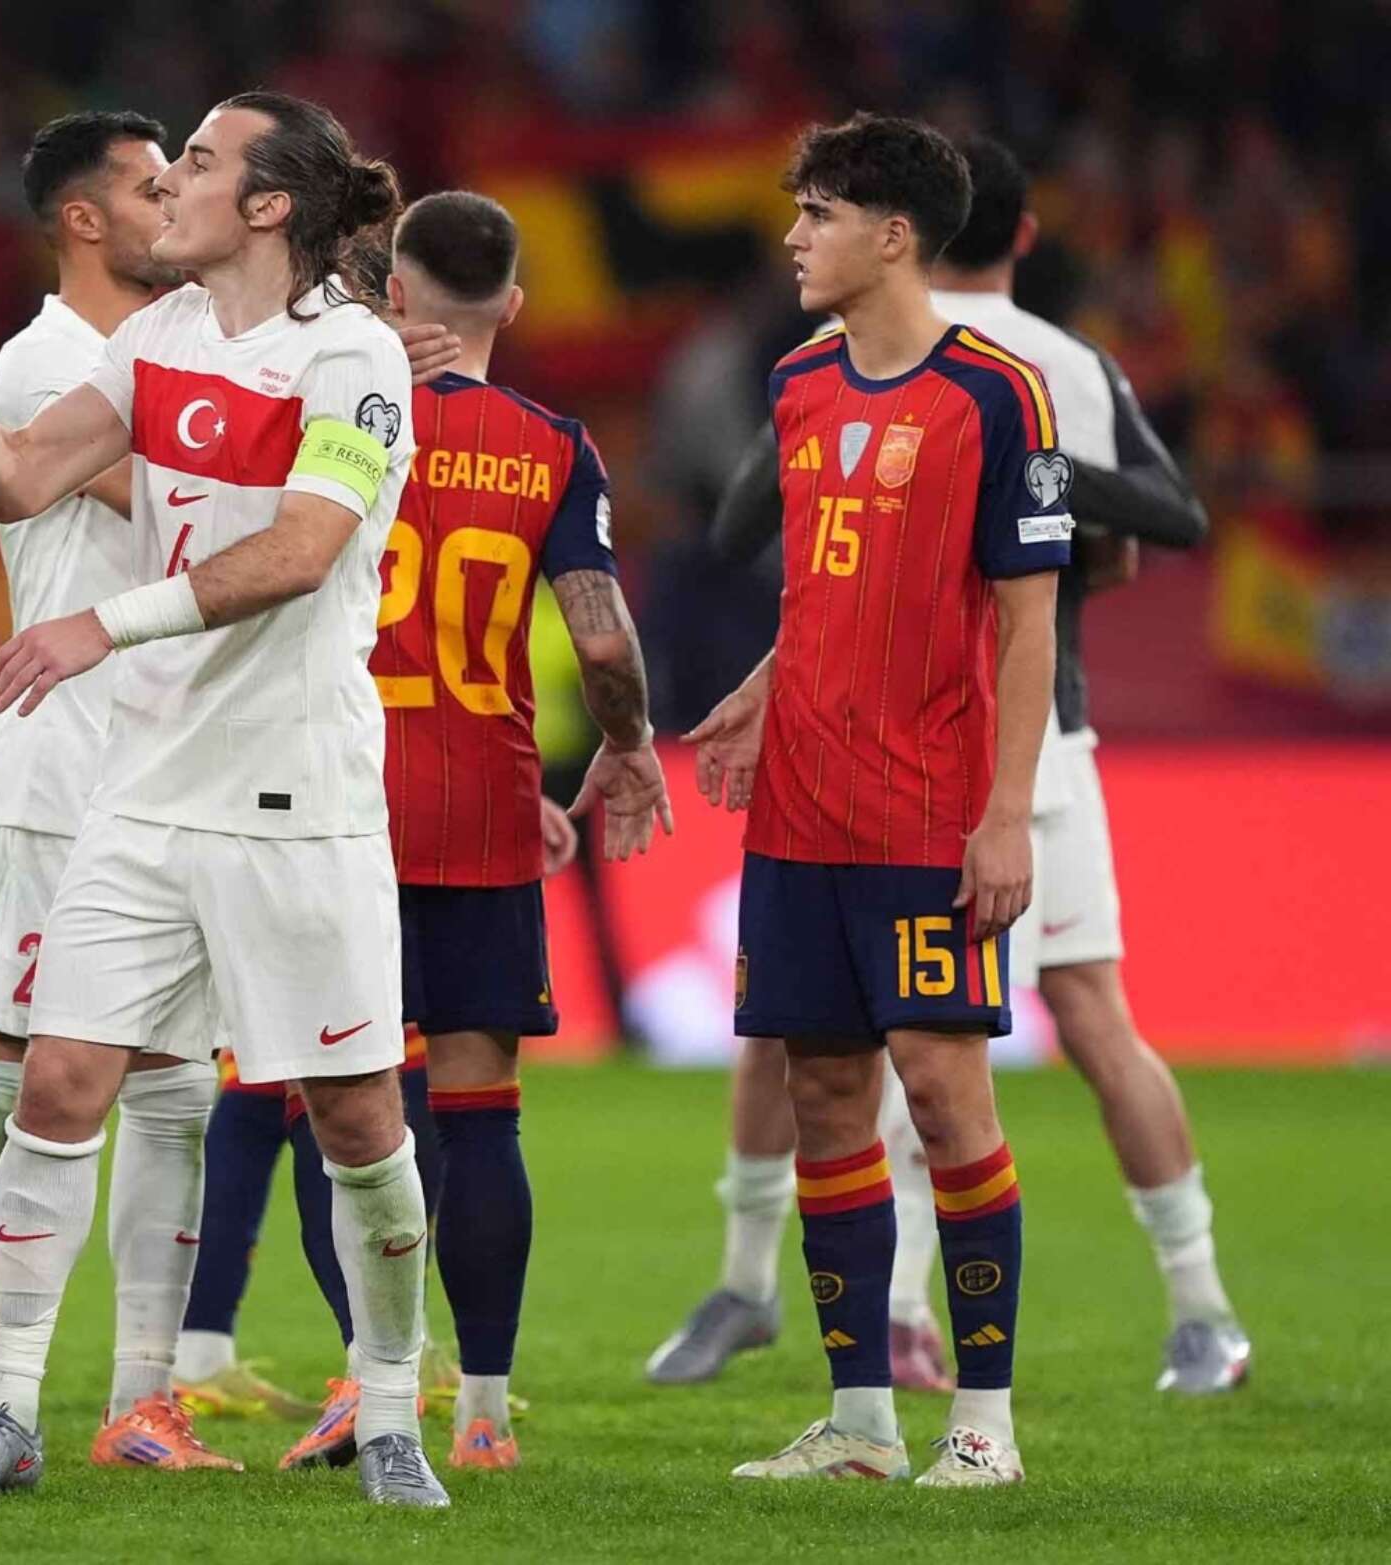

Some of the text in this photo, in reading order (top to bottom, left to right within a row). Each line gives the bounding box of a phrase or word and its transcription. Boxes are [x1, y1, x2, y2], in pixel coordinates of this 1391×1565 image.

[336, 447, 382, 483] RESPEC
[427, 450, 551, 503] GARCÍA
[811, 496, 864, 577] 15
[371, 519, 532, 716] 20
[895, 916, 955, 998] 15
